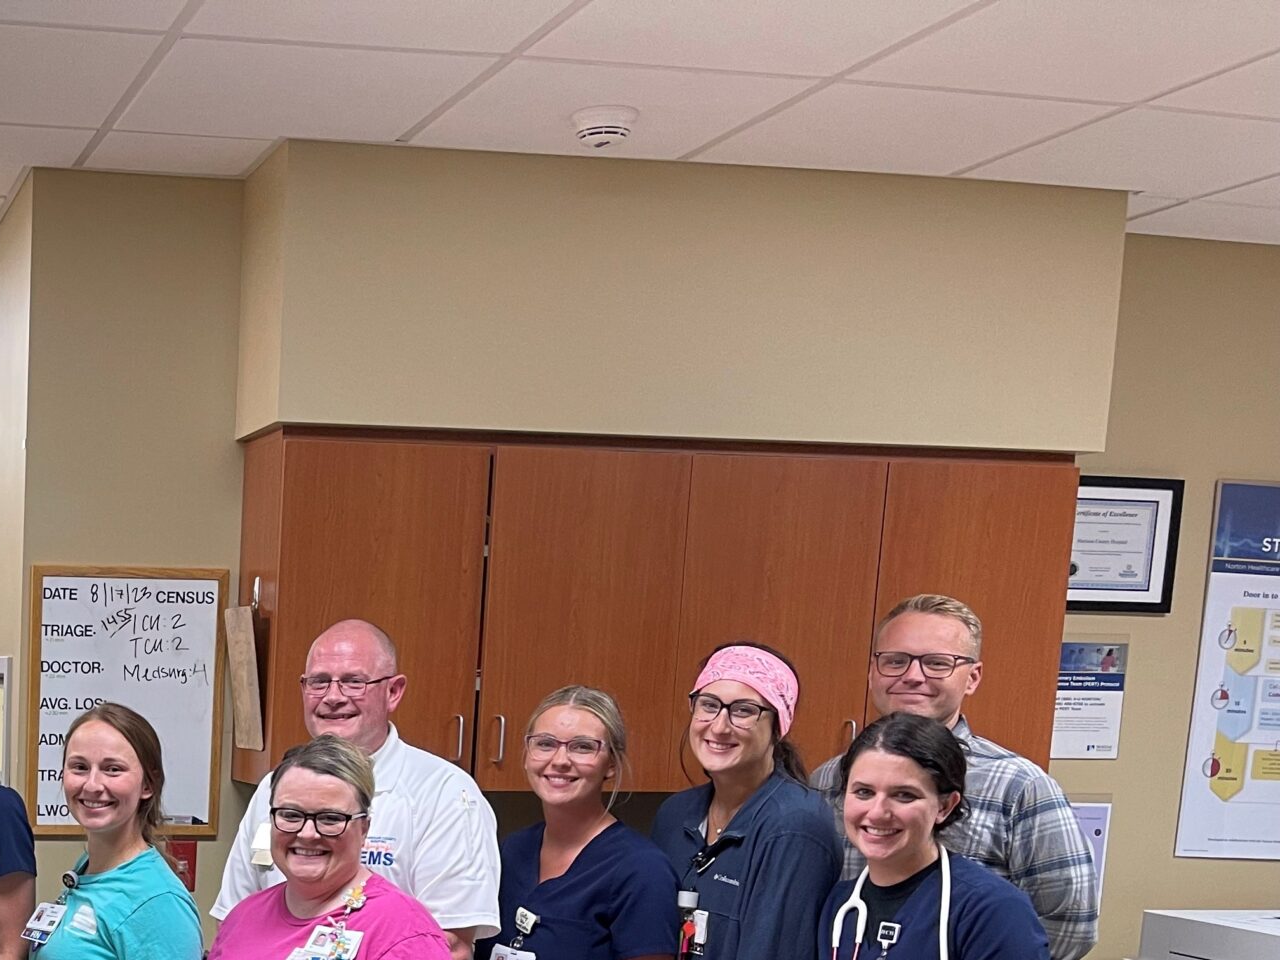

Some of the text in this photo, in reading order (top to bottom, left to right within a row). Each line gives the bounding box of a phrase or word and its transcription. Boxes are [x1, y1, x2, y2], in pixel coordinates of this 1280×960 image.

[1261, 537, 1280, 553] ST
[1247, 563, 1280, 572] Healthcare
[43, 587, 78, 601] DATE
[155, 590, 215, 604] CENSUS
[1243, 590, 1261, 598] Door
[171, 614, 186, 631] 2
[171, 637, 189, 651] 2
[39, 698, 72, 710] AVG.
[360, 851, 395, 866] EMS
